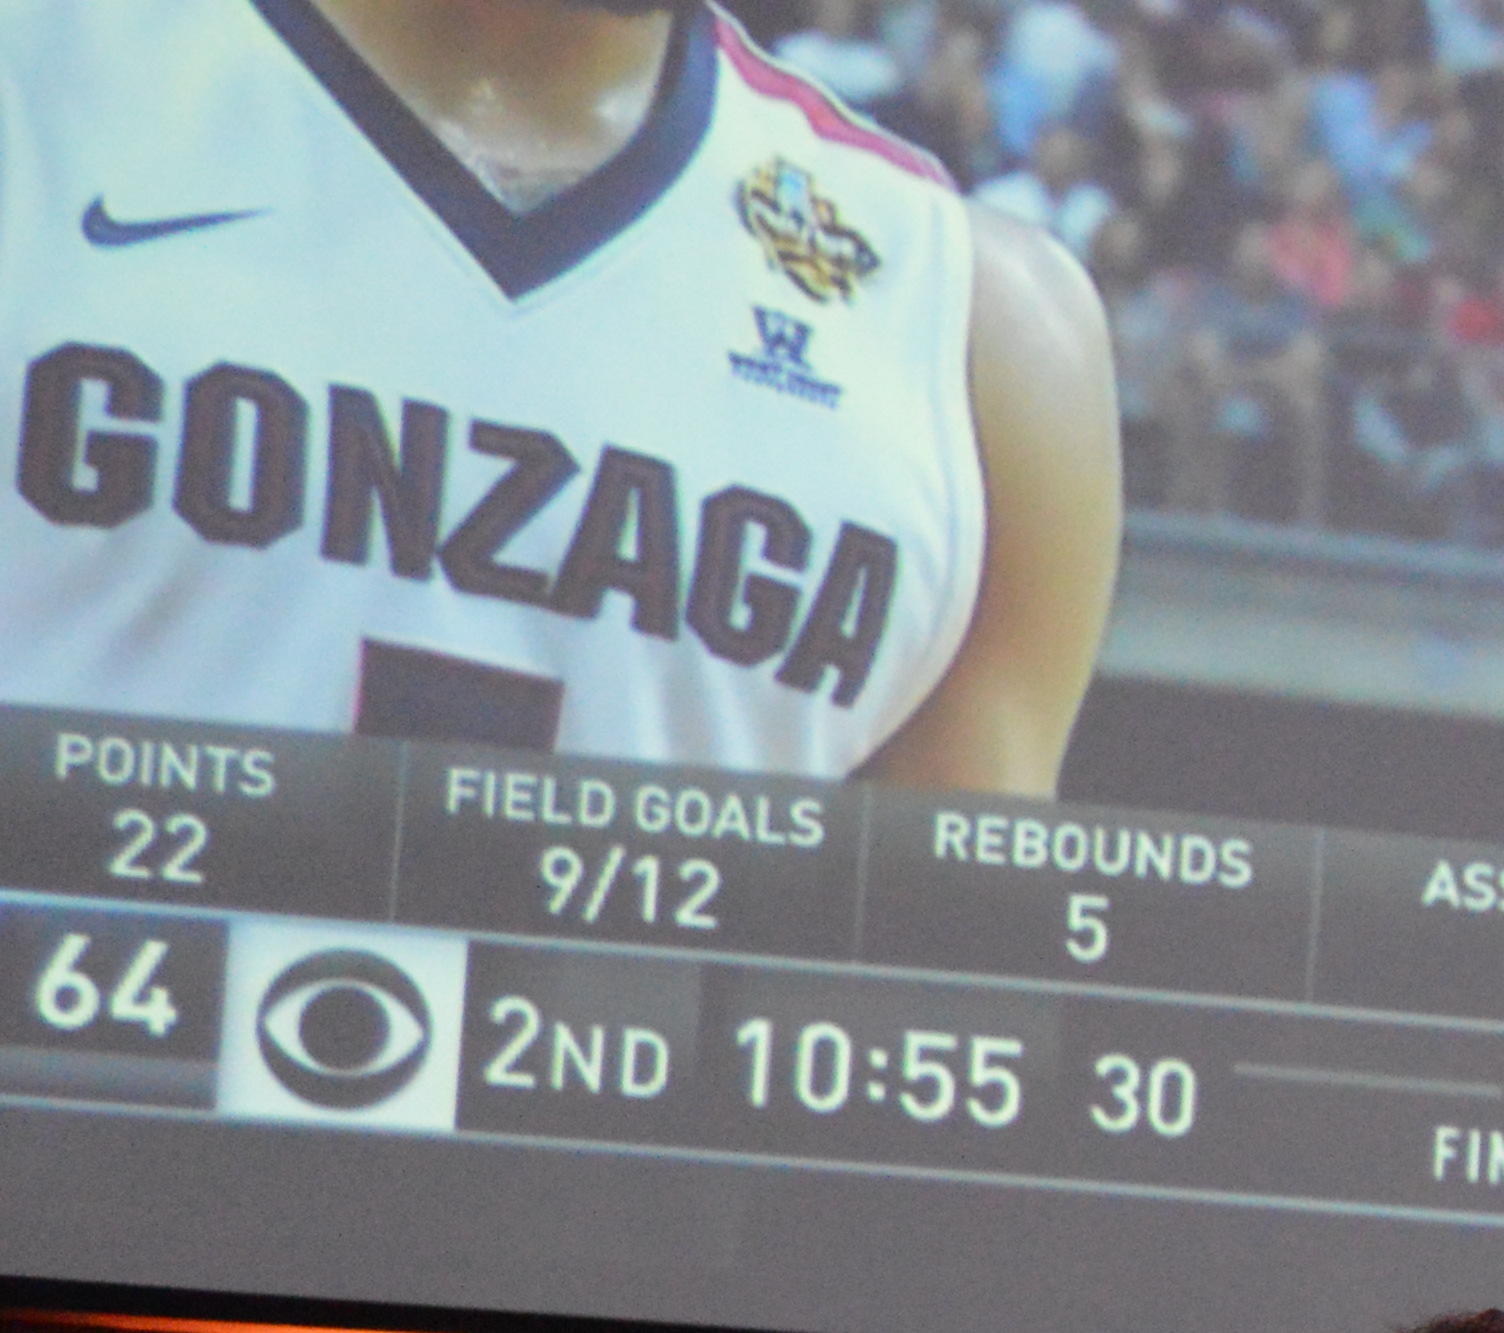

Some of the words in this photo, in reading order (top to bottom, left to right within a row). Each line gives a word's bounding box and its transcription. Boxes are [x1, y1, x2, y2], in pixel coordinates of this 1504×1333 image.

[15, 340, 899, 708] GONZAGA
[55, 731, 276, 798] POINTS
[109, 809, 210, 884] 22
[446, 766, 617, 829] FIELD
[634, 784, 825, 848] GOALS
[540, 845, 724, 930] 9/12
[933, 811, 1254, 889] REBOUNDS
[1065, 894, 1111, 963] 5
[35, 932, 179, 1038] 64
[485, 994, 671, 1099] 2ND
[734, 1015, 1025, 1128] 10:55
[1090, 1053, 1197, 1138] 30
